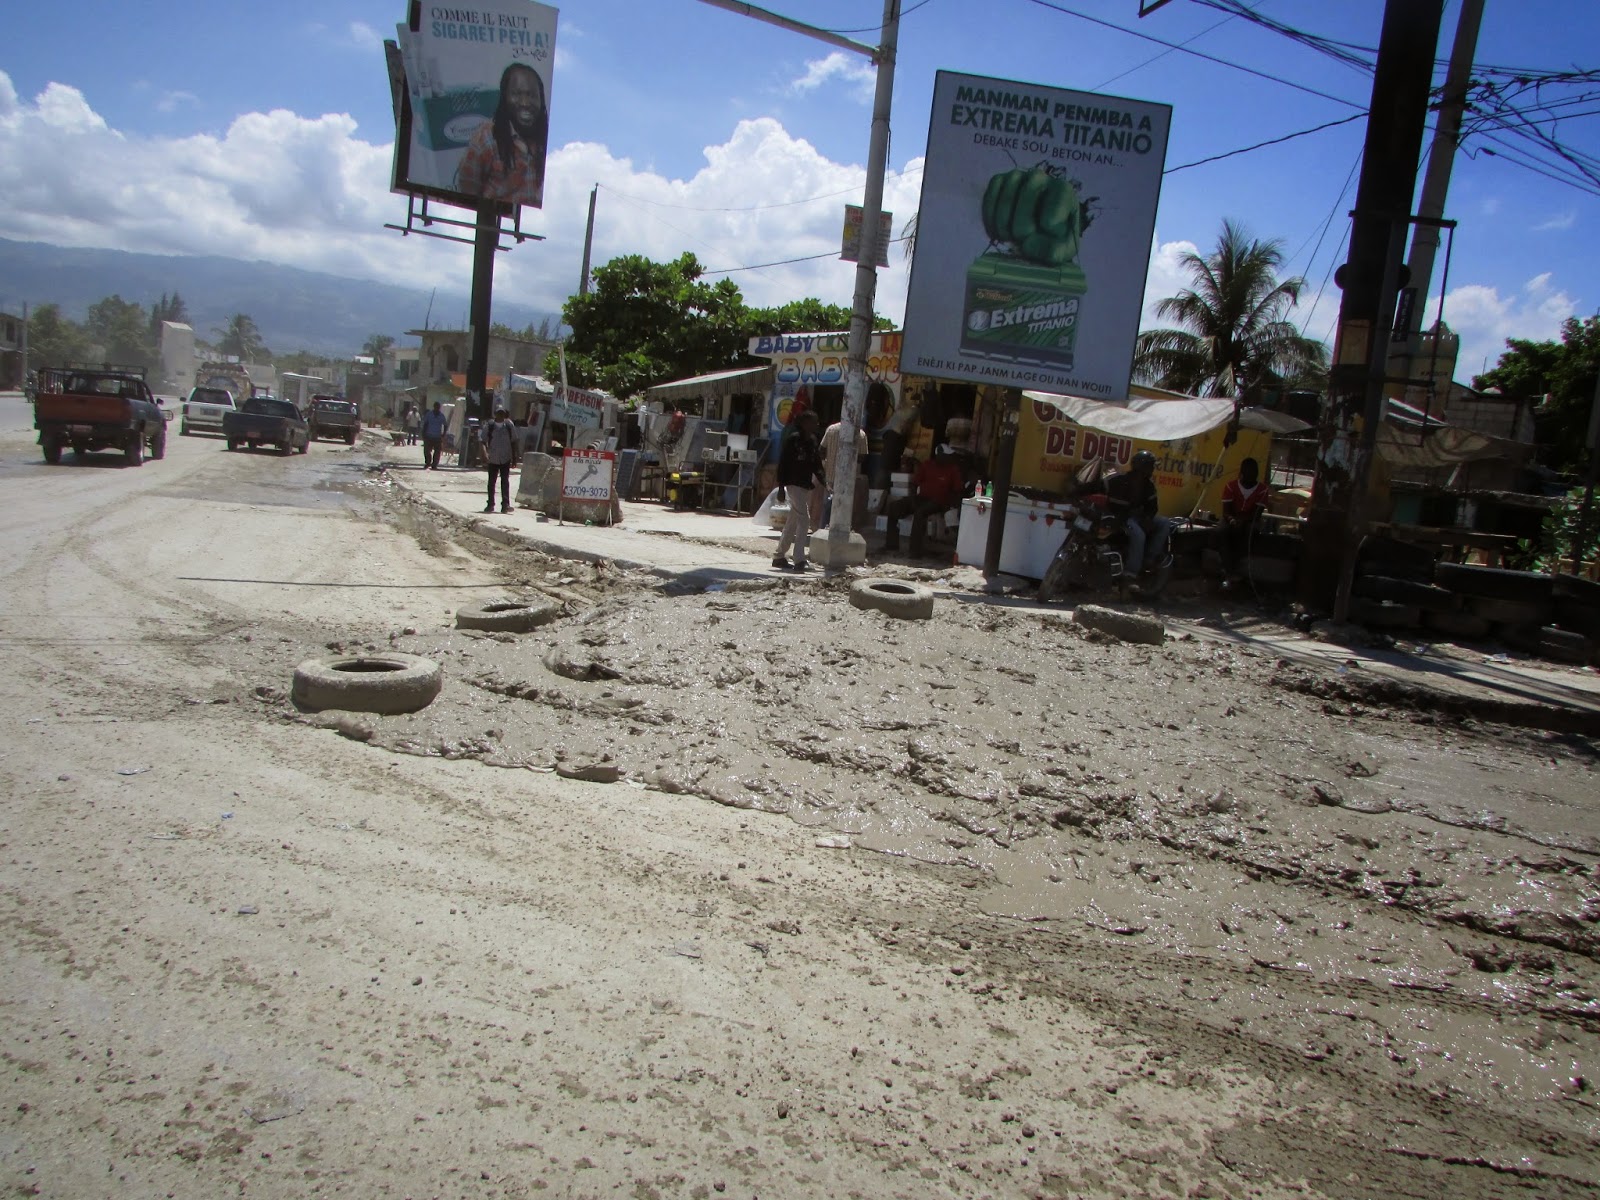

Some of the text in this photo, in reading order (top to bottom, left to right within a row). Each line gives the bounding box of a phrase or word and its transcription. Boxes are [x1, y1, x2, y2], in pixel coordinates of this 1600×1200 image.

[431, 8, 529, 29] COMME IL FAUT
[432, 22, 494, 42] SIGARET
[499, 28, 531, 46] PEYI
[955, 85, 1152, 132] MANMAN PENMBA A
[950, 104, 1153, 155] EXTREMA TITANIO
[973, 132, 1019, 150] DEBAKE
[1021, 139, 1050, 155] SOU
[1051, 143, 1092, 163] BETON
[989, 299, 1079, 329] Extrema
[1027, 315, 1075, 334] TITANIO
[754, 336, 815, 355] BABY
[945, 360, 956, 371] KI
[957, 362, 977, 374] PAP
[979, 366, 1009, 378] JANM
[1011, 370, 1038, 382] LAGE
[1038, 374, 1055, 385] OU
[1056, 376, 1079, 388] NAN
[1045, 425, 1077, 457] DE
[1081, 431, 1132, 465] DIEU
[567, 485, 608, 498] 3709-3073
